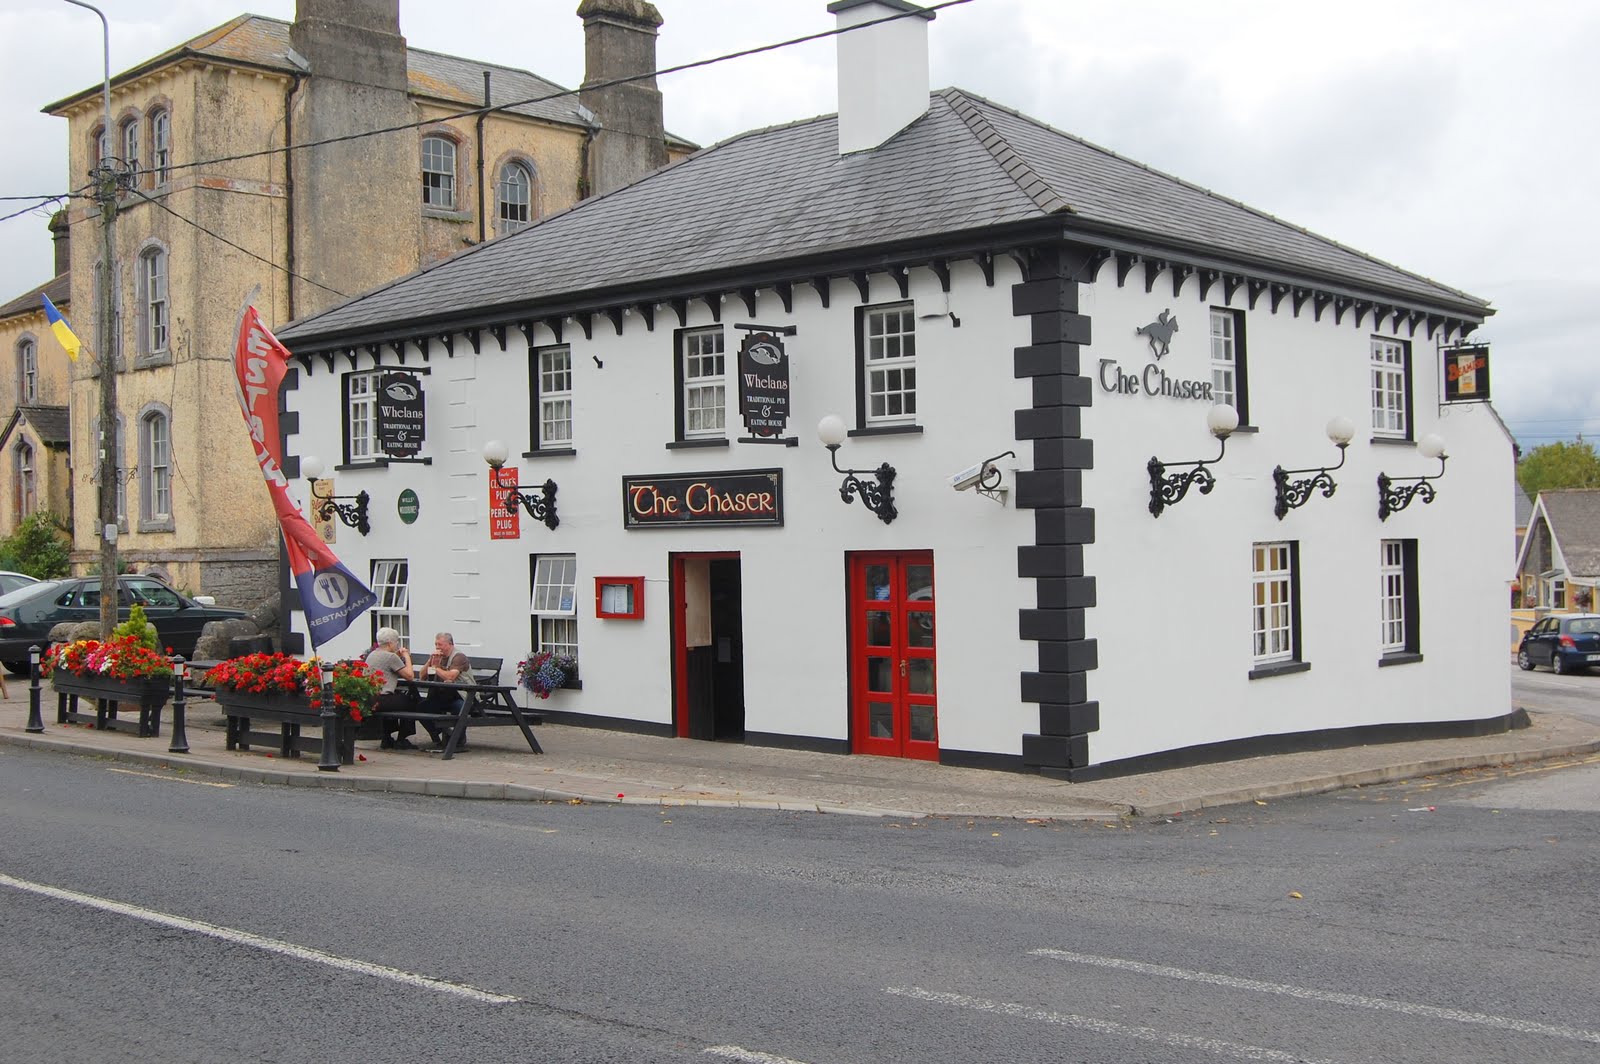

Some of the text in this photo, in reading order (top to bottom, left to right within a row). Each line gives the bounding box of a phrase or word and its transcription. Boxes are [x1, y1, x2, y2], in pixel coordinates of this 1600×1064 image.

[744, 373, 788, 390] Whelans
[1099, 358, 1214, 401] The Chaser
[746, 395, 786, 405] TRADITIONAL PUB
[381, 405, 424, 419] Whelans
[761, 405, 772, 418] &
[397, 430, 408, 442] &
[629, 482, 774, 516] The Chaser
[496, 520, 513, 530] PLUG
